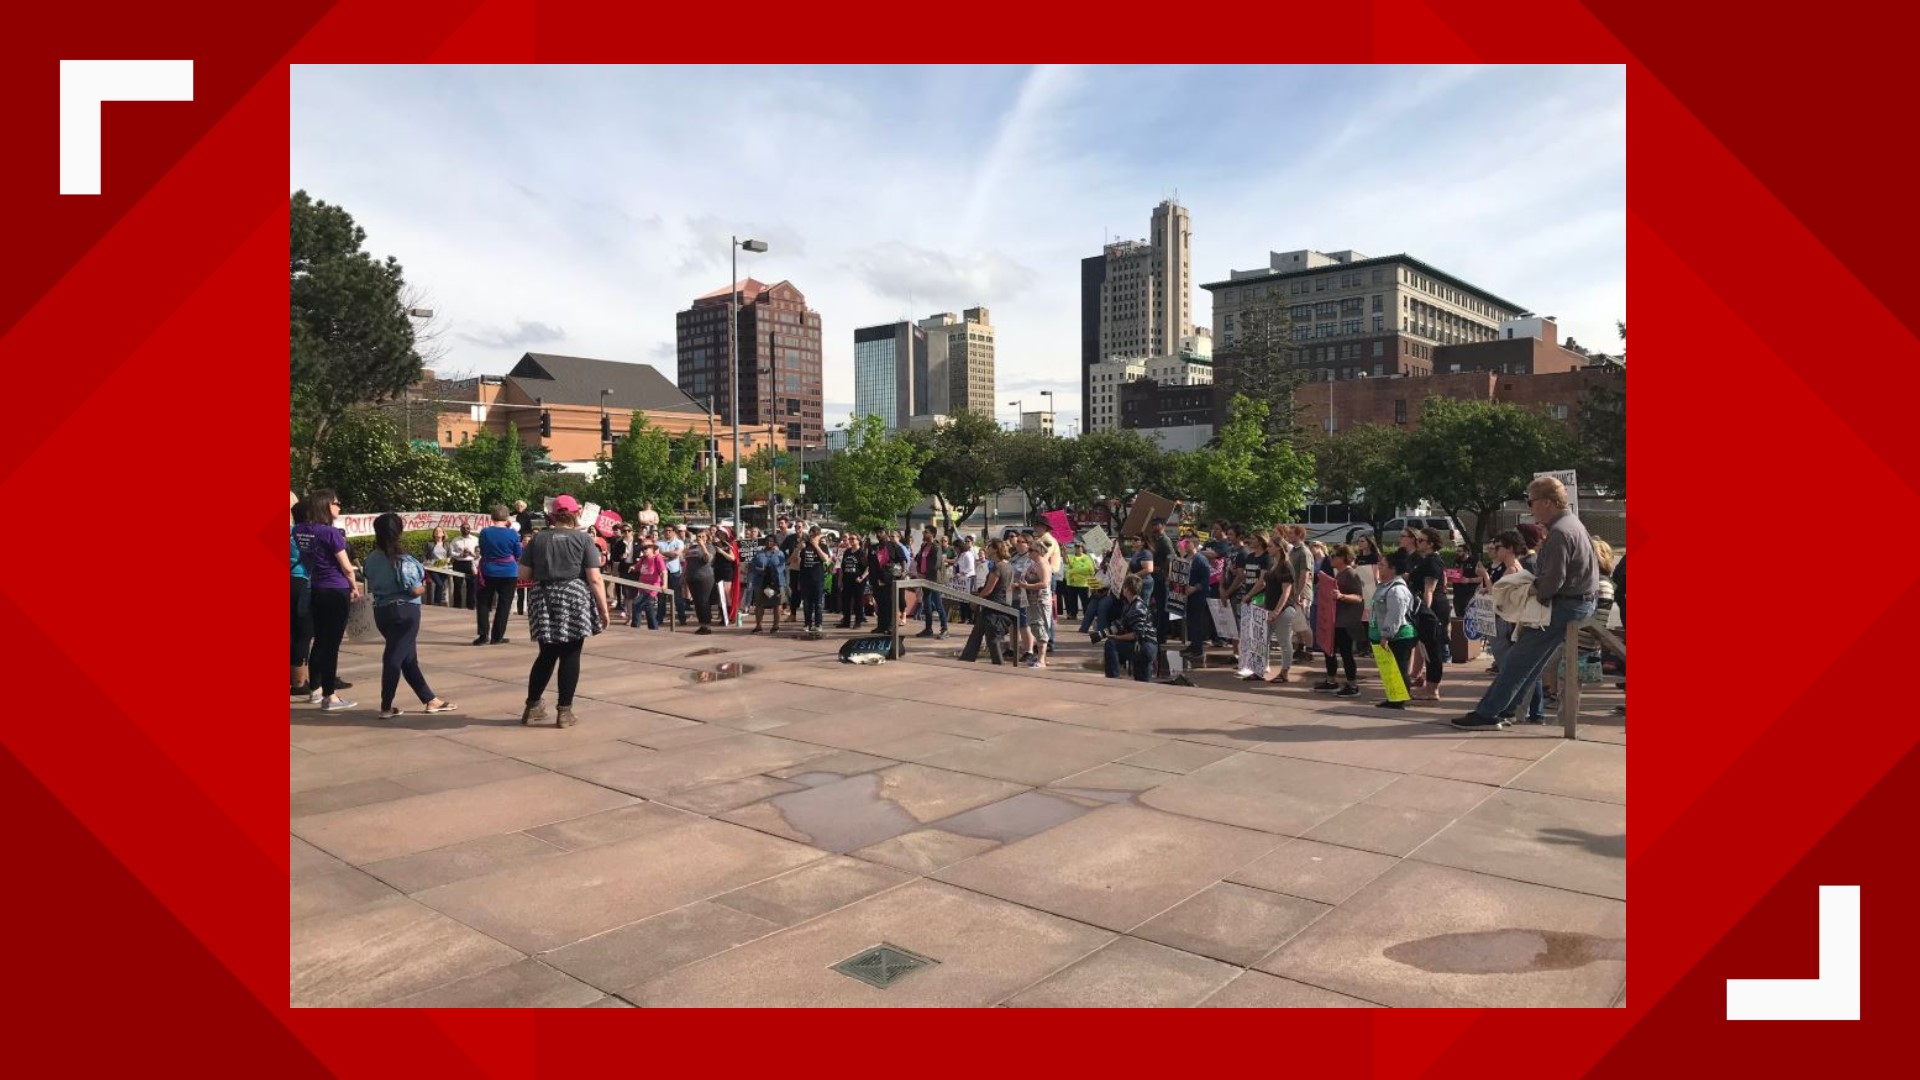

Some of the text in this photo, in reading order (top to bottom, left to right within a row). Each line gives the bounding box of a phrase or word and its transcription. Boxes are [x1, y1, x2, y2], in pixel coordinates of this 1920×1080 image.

[415, 513, 433, 521] ARE
[408, 519, 438, 529] NOT
[437, 514, 492, 531] PHYSICIAN
